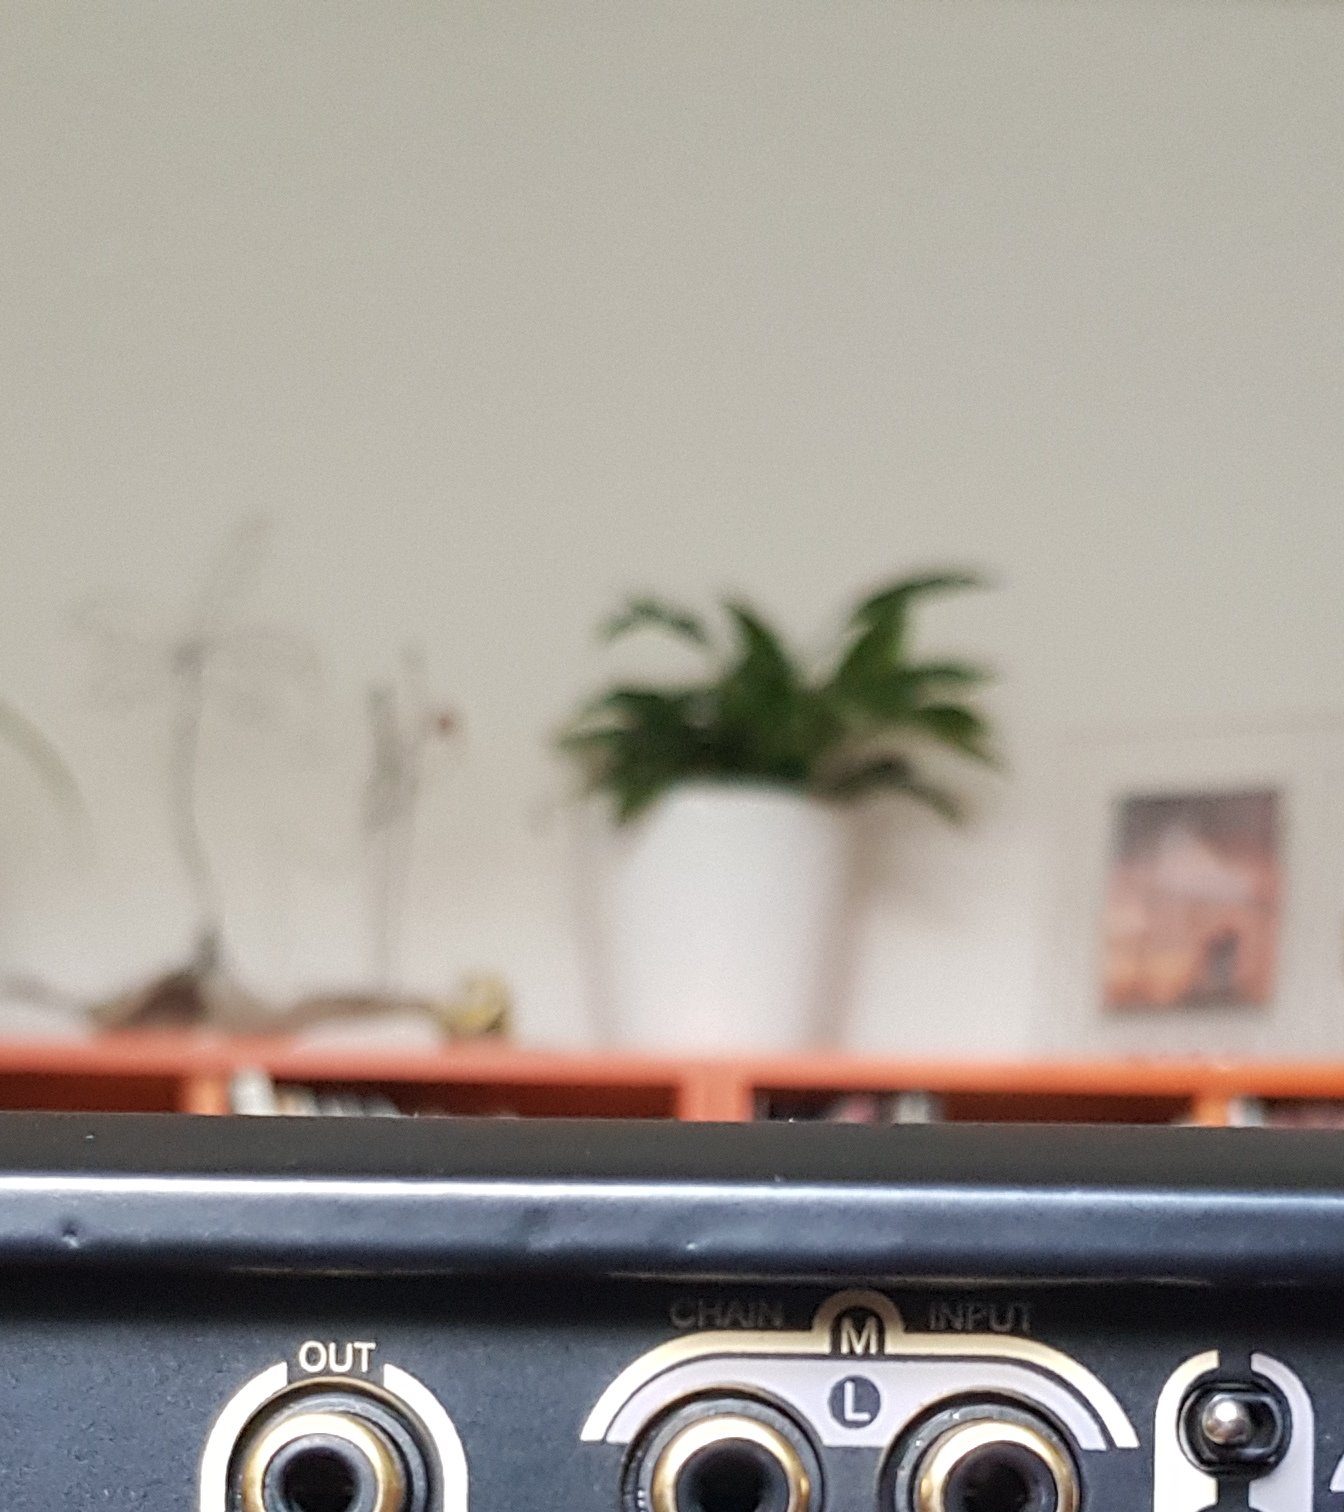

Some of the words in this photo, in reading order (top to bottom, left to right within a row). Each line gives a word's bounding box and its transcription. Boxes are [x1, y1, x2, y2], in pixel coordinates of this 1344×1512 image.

[670, 1299, 783, 1328] CHAIN
[929, 1301, 1032, 1332] INPUT
[299, 1341, 376, 1373] OUT
